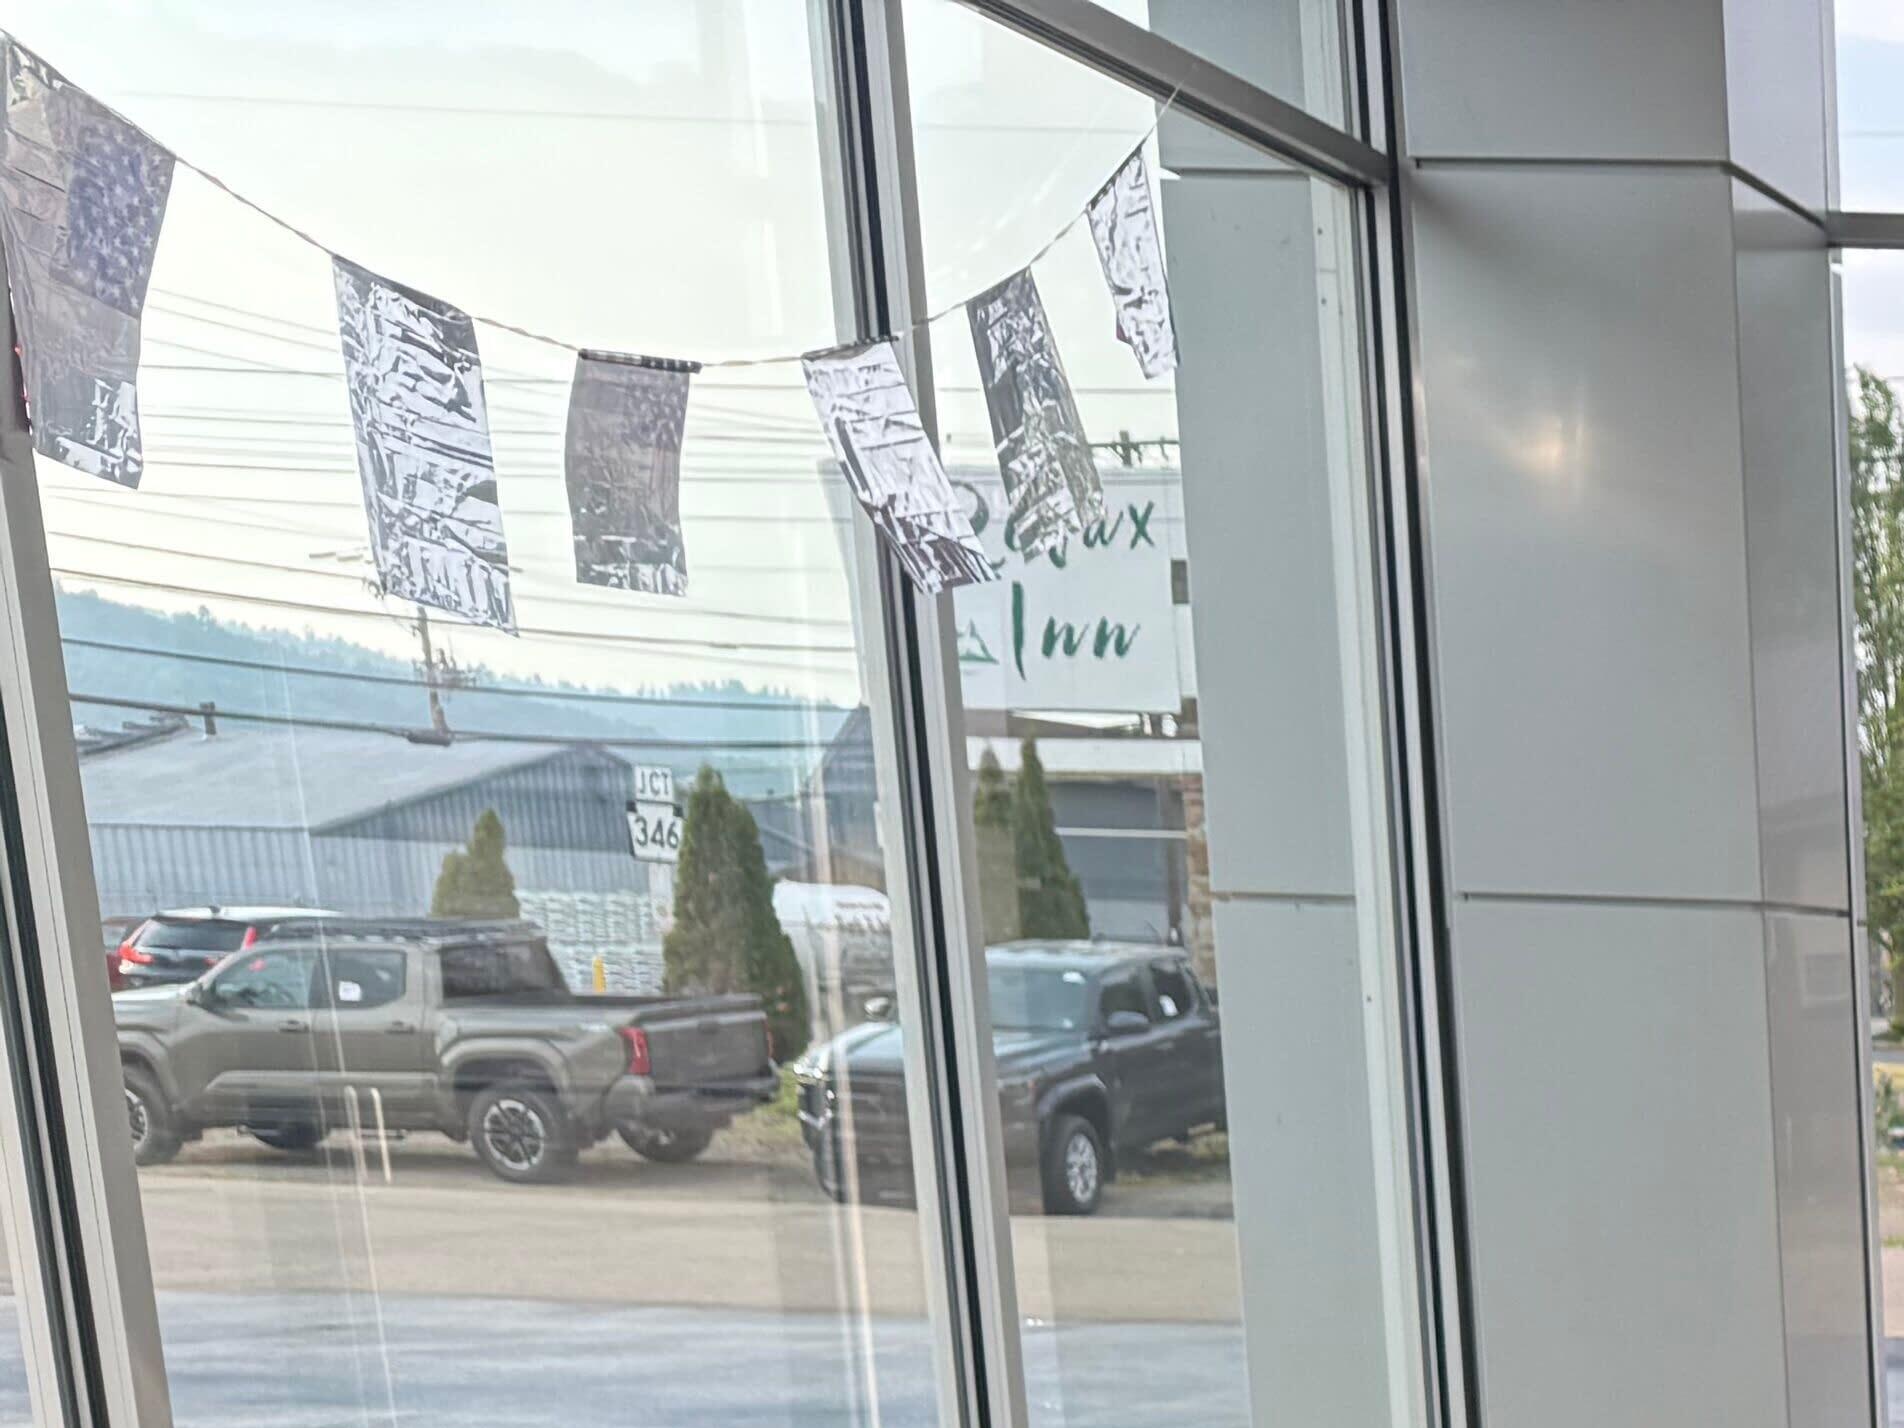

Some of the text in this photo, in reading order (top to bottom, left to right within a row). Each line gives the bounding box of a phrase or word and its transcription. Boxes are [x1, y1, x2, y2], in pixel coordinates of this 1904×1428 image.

[1011, 580, 1141, 682] Inn
[639, 770, 669, 796] JCT
[636, 816, 680, 849] 346
